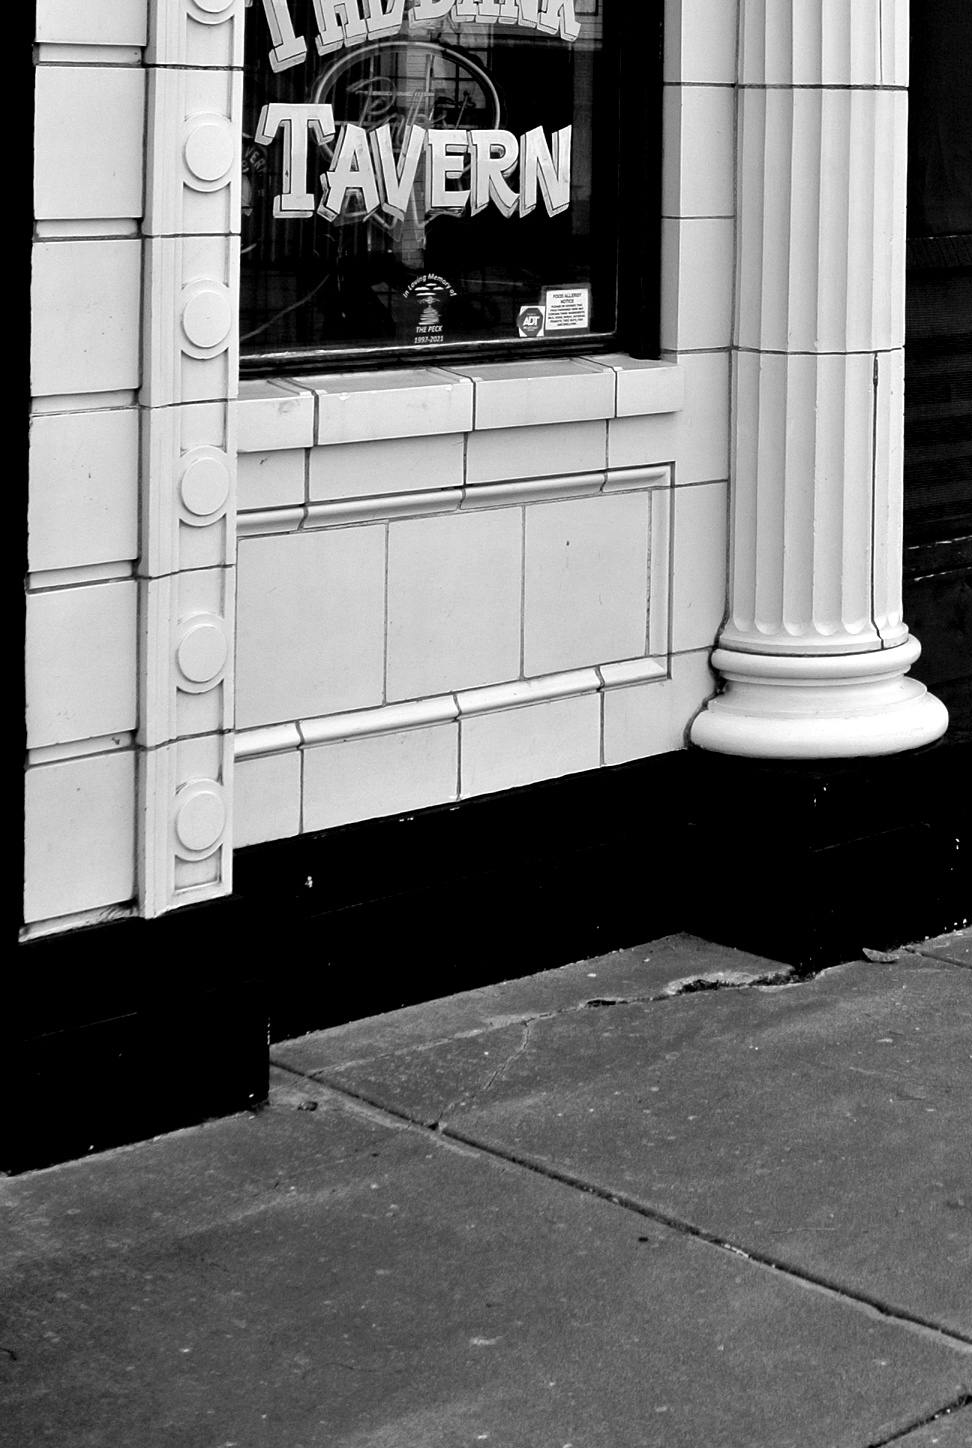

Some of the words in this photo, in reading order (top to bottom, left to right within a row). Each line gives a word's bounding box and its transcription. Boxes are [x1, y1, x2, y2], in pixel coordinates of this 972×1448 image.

[254, 102, 572, 222] TAVERN
[428, 273, 452, 290] Memory
[522, 316, 540, 327] ADT
